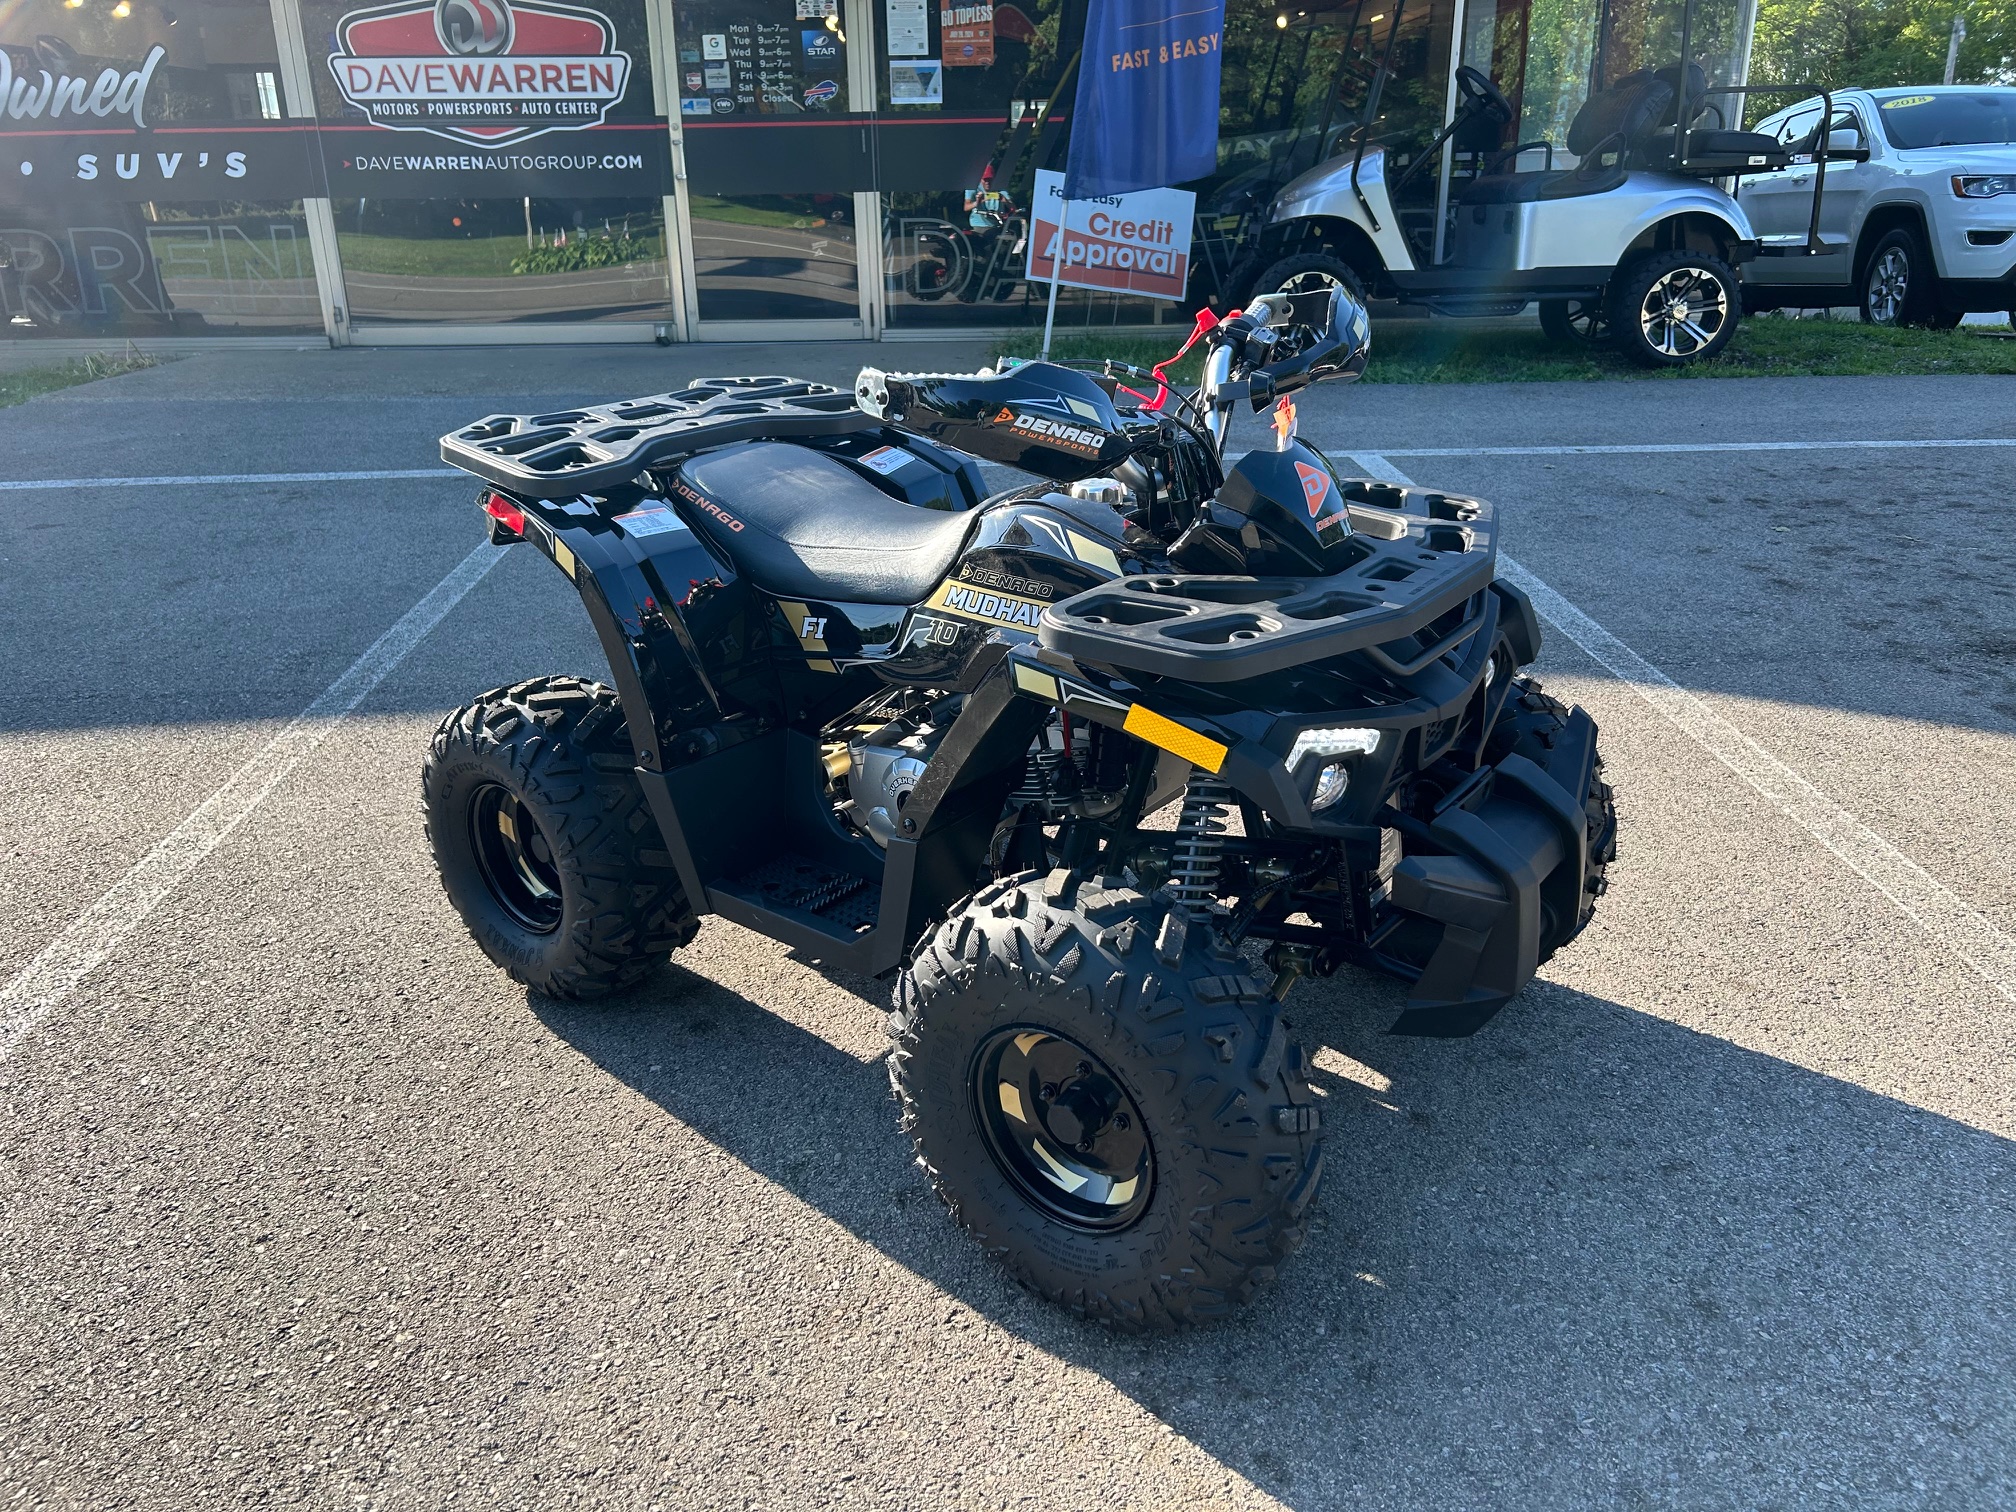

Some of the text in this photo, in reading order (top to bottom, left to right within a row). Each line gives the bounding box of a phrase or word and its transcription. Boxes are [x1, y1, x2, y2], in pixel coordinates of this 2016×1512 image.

[941, 9, 954, 27] GO
[954, 4, 994, 25] TOPLESS
[729, 24, 749, 33] Mon
[733, 36, 750, 45] Tue
[729, 48, 751, 57] Wed
[807, 47, 836, 56] STAR
[1111, 32, 1220, 73] FAST & EASY
[734, 59, 752, 68] Thu
[739, 71, 753, 80] Fri
[738, 83, 754, 92] Sat
[737, 93, 794, 103] Sun Closed
[1891, 96, 1927, 108] 2018
[372, 101, 599, 116] MOTORS POWERSPORTS AUTO CENTER
[76, 151, 248, 181] SUV'S
[355, 154, 644, 171] DAVEWARRENAUTOGROUP.COM
[1088, 211, 1174, 247] Credit
[1043, 231, 1180, 276] Approval
[1012, 412, 1106, 449] DENAGO
[1008, 426, 1100, 456] POWERSPORTS
[676, 483, 746, 534] DENAGO
[973, 568, 1055, 599] DENAGO
[799, 616, 829, 640] FI
